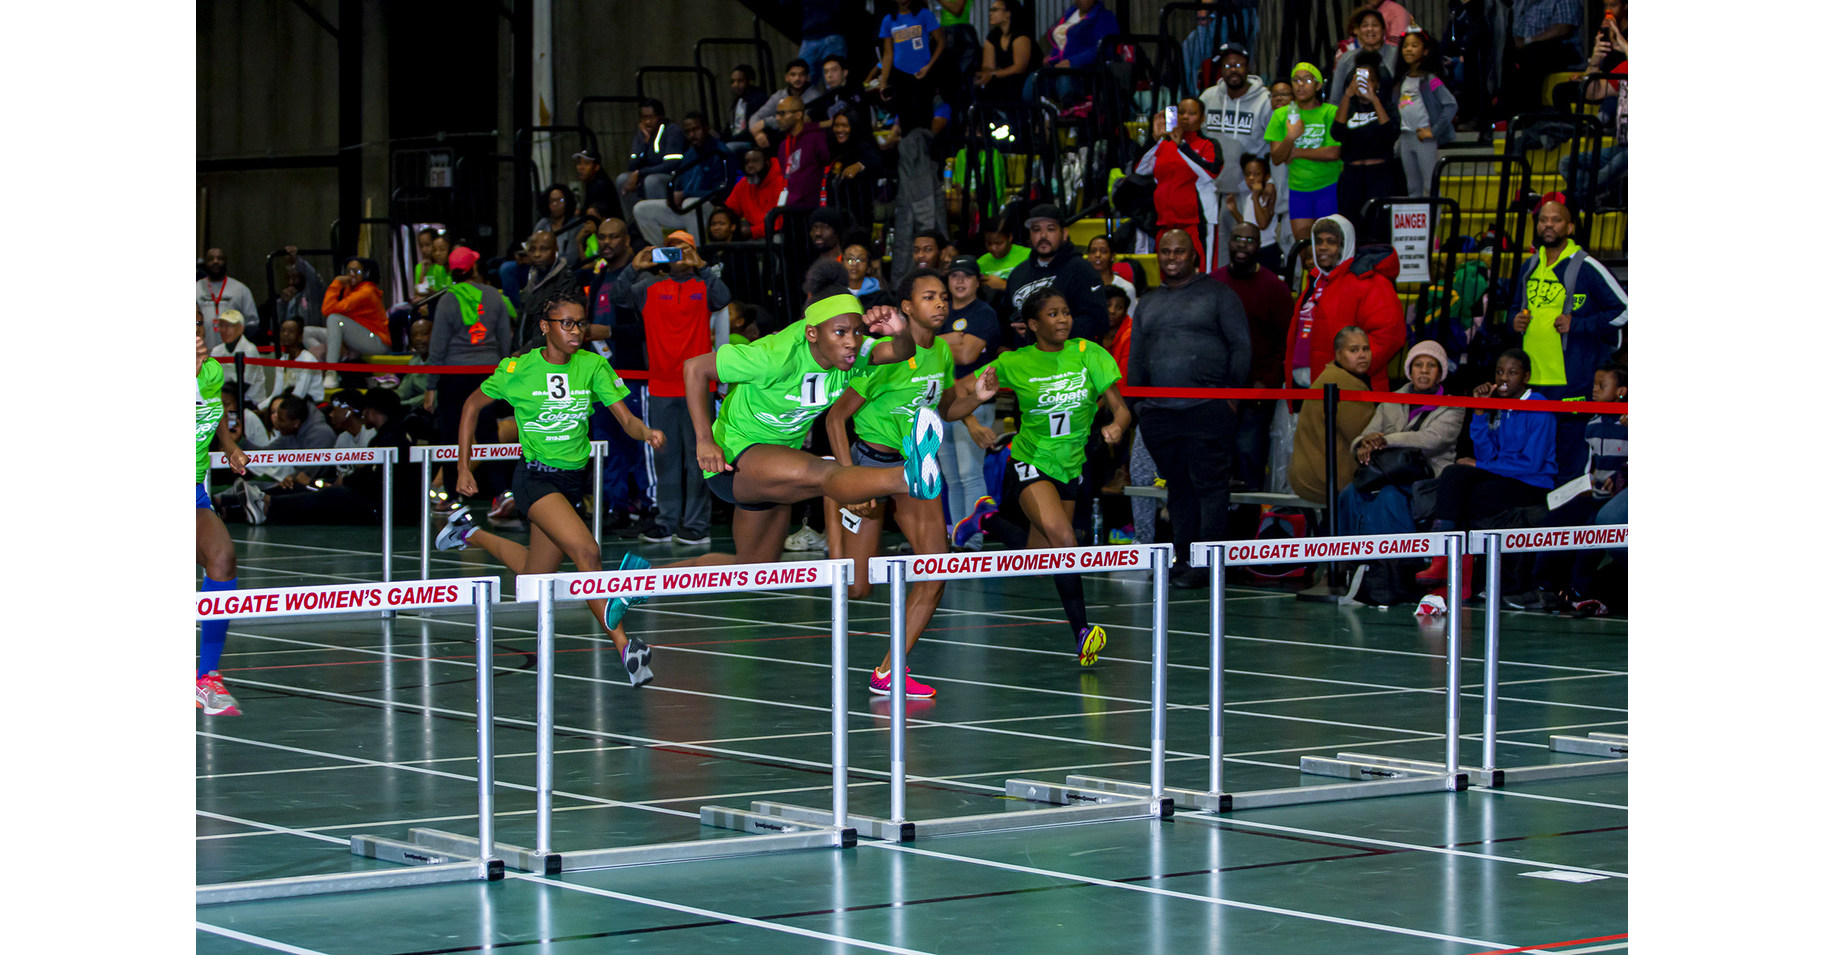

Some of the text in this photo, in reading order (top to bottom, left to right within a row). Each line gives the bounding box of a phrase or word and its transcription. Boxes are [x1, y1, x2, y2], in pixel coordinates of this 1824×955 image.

[1394, 213, 1427, 229] DANGER
[550, 375, 567, 399] 3
[806, 374, 819, 404] 1
[925, 381, 937, 404] 4
[1038, 388, 1089, 404] Colgate
[1052, 413, 1066, 435] 7
[221, 452, 375, 464] CATE WOMEN'S GAMES
[436, 447, 487, 458] COLTE
[1017, 462, 1031, 478] 7
[1505, 528, 1628, 548] COLGATE WOMEN'
[1228, 539, 1430, 560] COLGATE WOMEN'S GAMES
[913, 549, 1139, 575] COLGATE WOMEN'S GAMES
[569, 567, 817, 595] COLGATE WOMEN'S GAMES
[196, 585, 458, 616] OLGATE WOMEN'S GAMES
